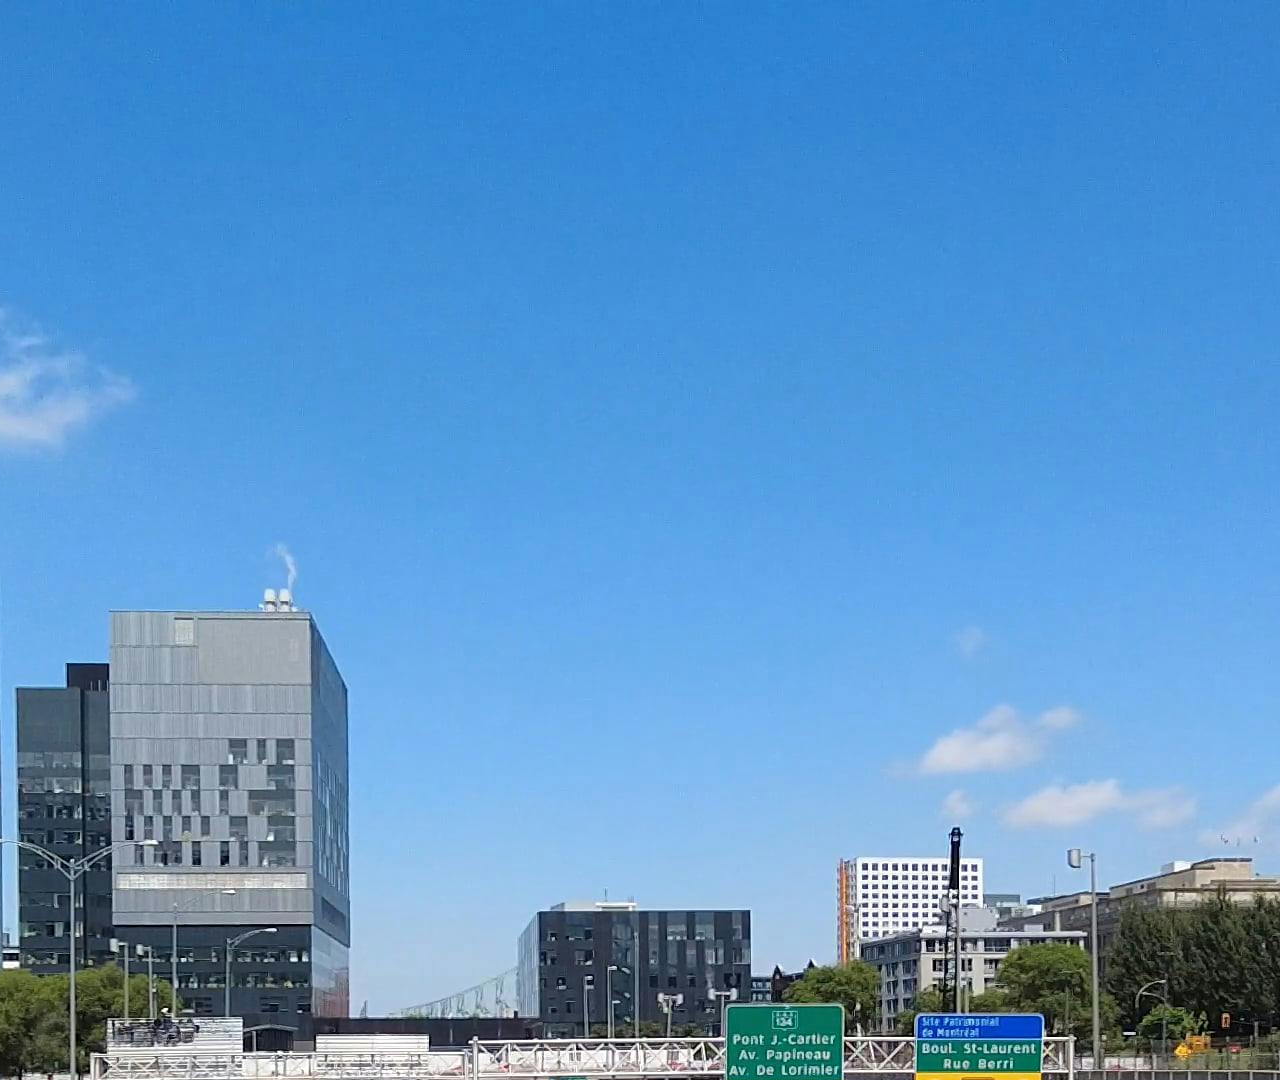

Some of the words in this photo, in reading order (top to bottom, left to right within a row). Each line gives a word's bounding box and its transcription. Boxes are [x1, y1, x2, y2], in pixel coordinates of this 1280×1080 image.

[733, 1034, 764, 1045] Pont
[771, 1034, 836, 1045] J.-Cartier
[964, 1043, 1036, 1054] St-Laurent
[739, 1050, 759, 1060] Av.
[767, 1048, 830, 1062] Papineau
[943, 1059, 970, 1069] Rue
[978, 1058, 1014, 1069] Berri
[757, 1065, 774, 1075] De
[782, 1064, 839, 1076] Lorimier
